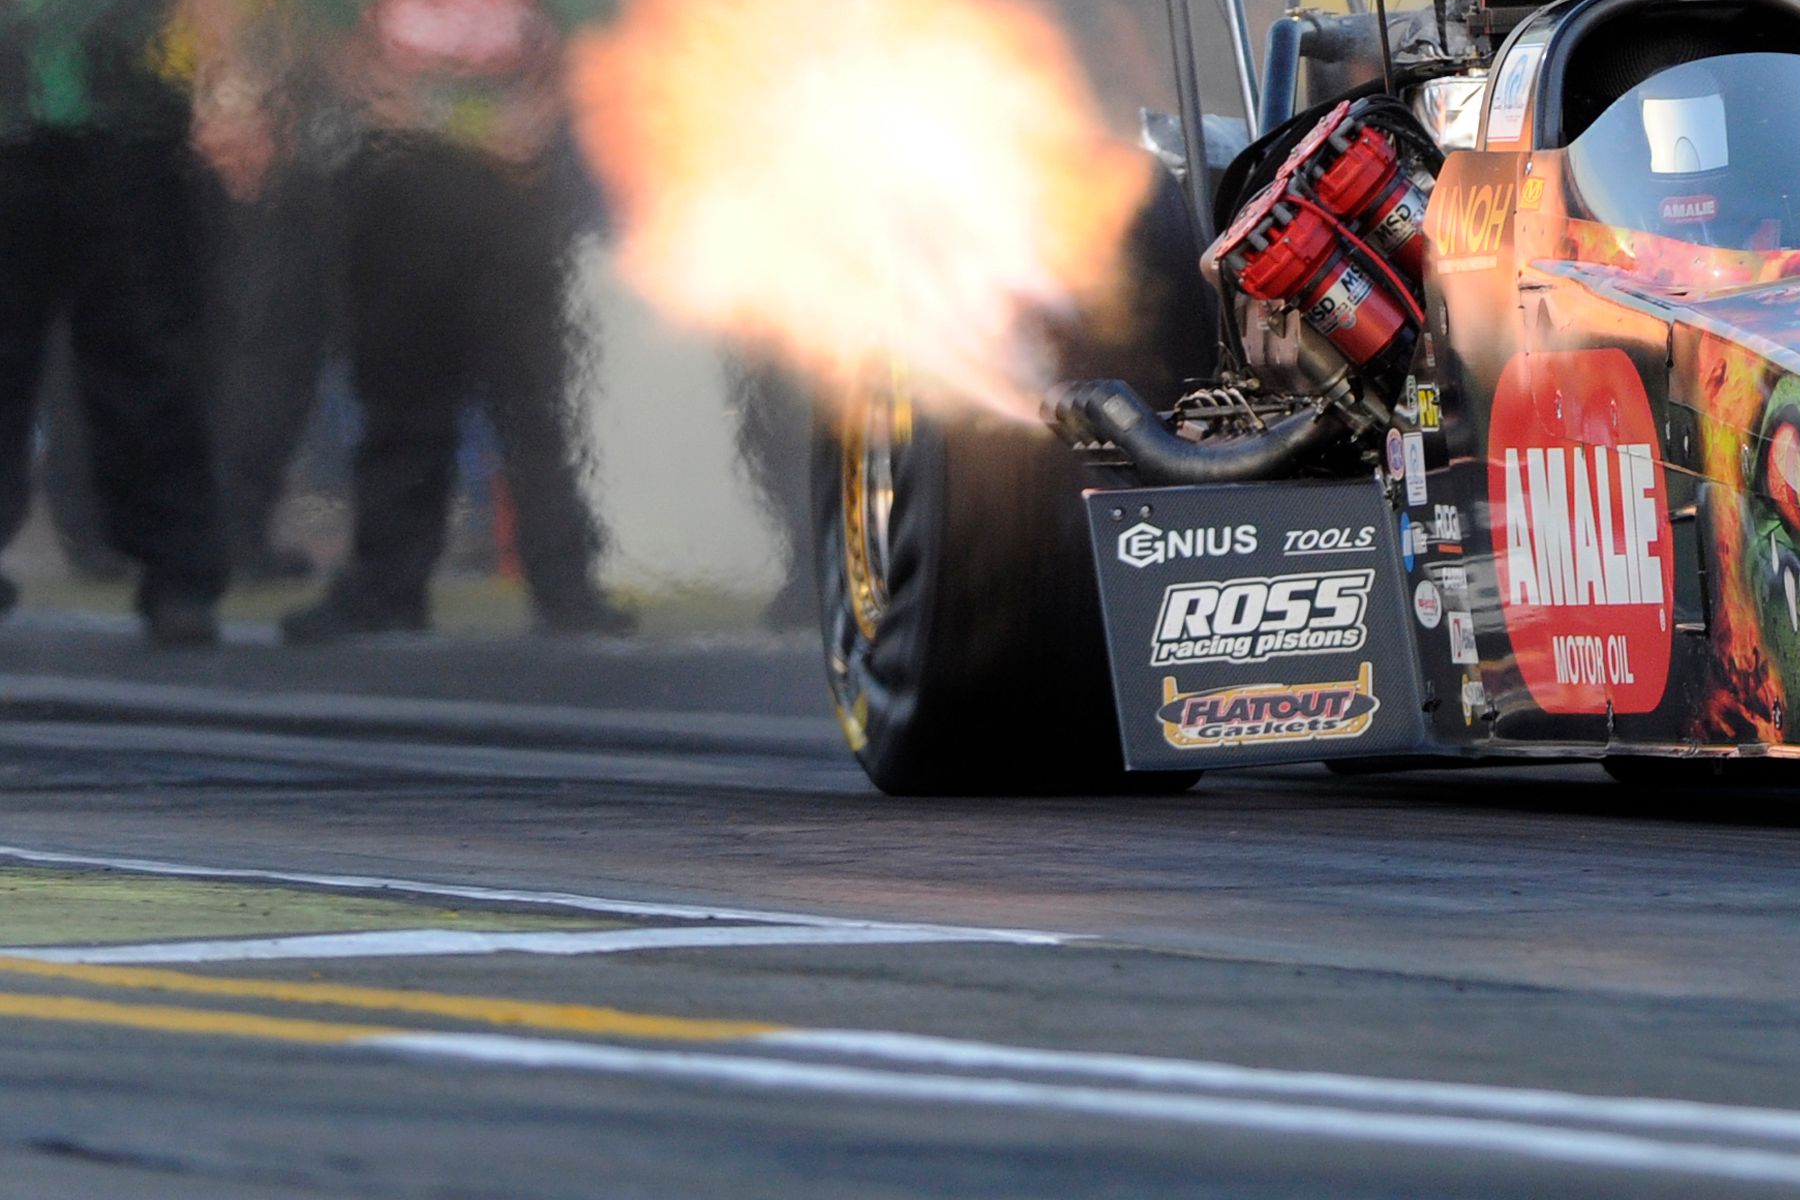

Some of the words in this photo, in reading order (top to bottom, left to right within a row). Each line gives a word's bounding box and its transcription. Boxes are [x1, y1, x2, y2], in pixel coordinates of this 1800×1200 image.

[1374, 204, 1412, 244] MSD
[1436, 183, 1513, 257] UNOH
[1662, 200, 1715, 219] AMALIE
[1117, 523, 1258, 568] GENIUS
[1284, 525, 1376, 552] TOOLS
[1508, 443, 1664, 606] AMALIE
[1158, 574, 1371, 641] ROSS
[1156, 634, 1250, 660] racing
[1253, 625, 1366, 658] pistons
[1553, 635, 1606, 685] MOTOR
[1607, 635, 1635, 685] OIL
[1184, 687, 1356, 728] FLATOUT
[1197, 716, 1340, 740] Gaskets
